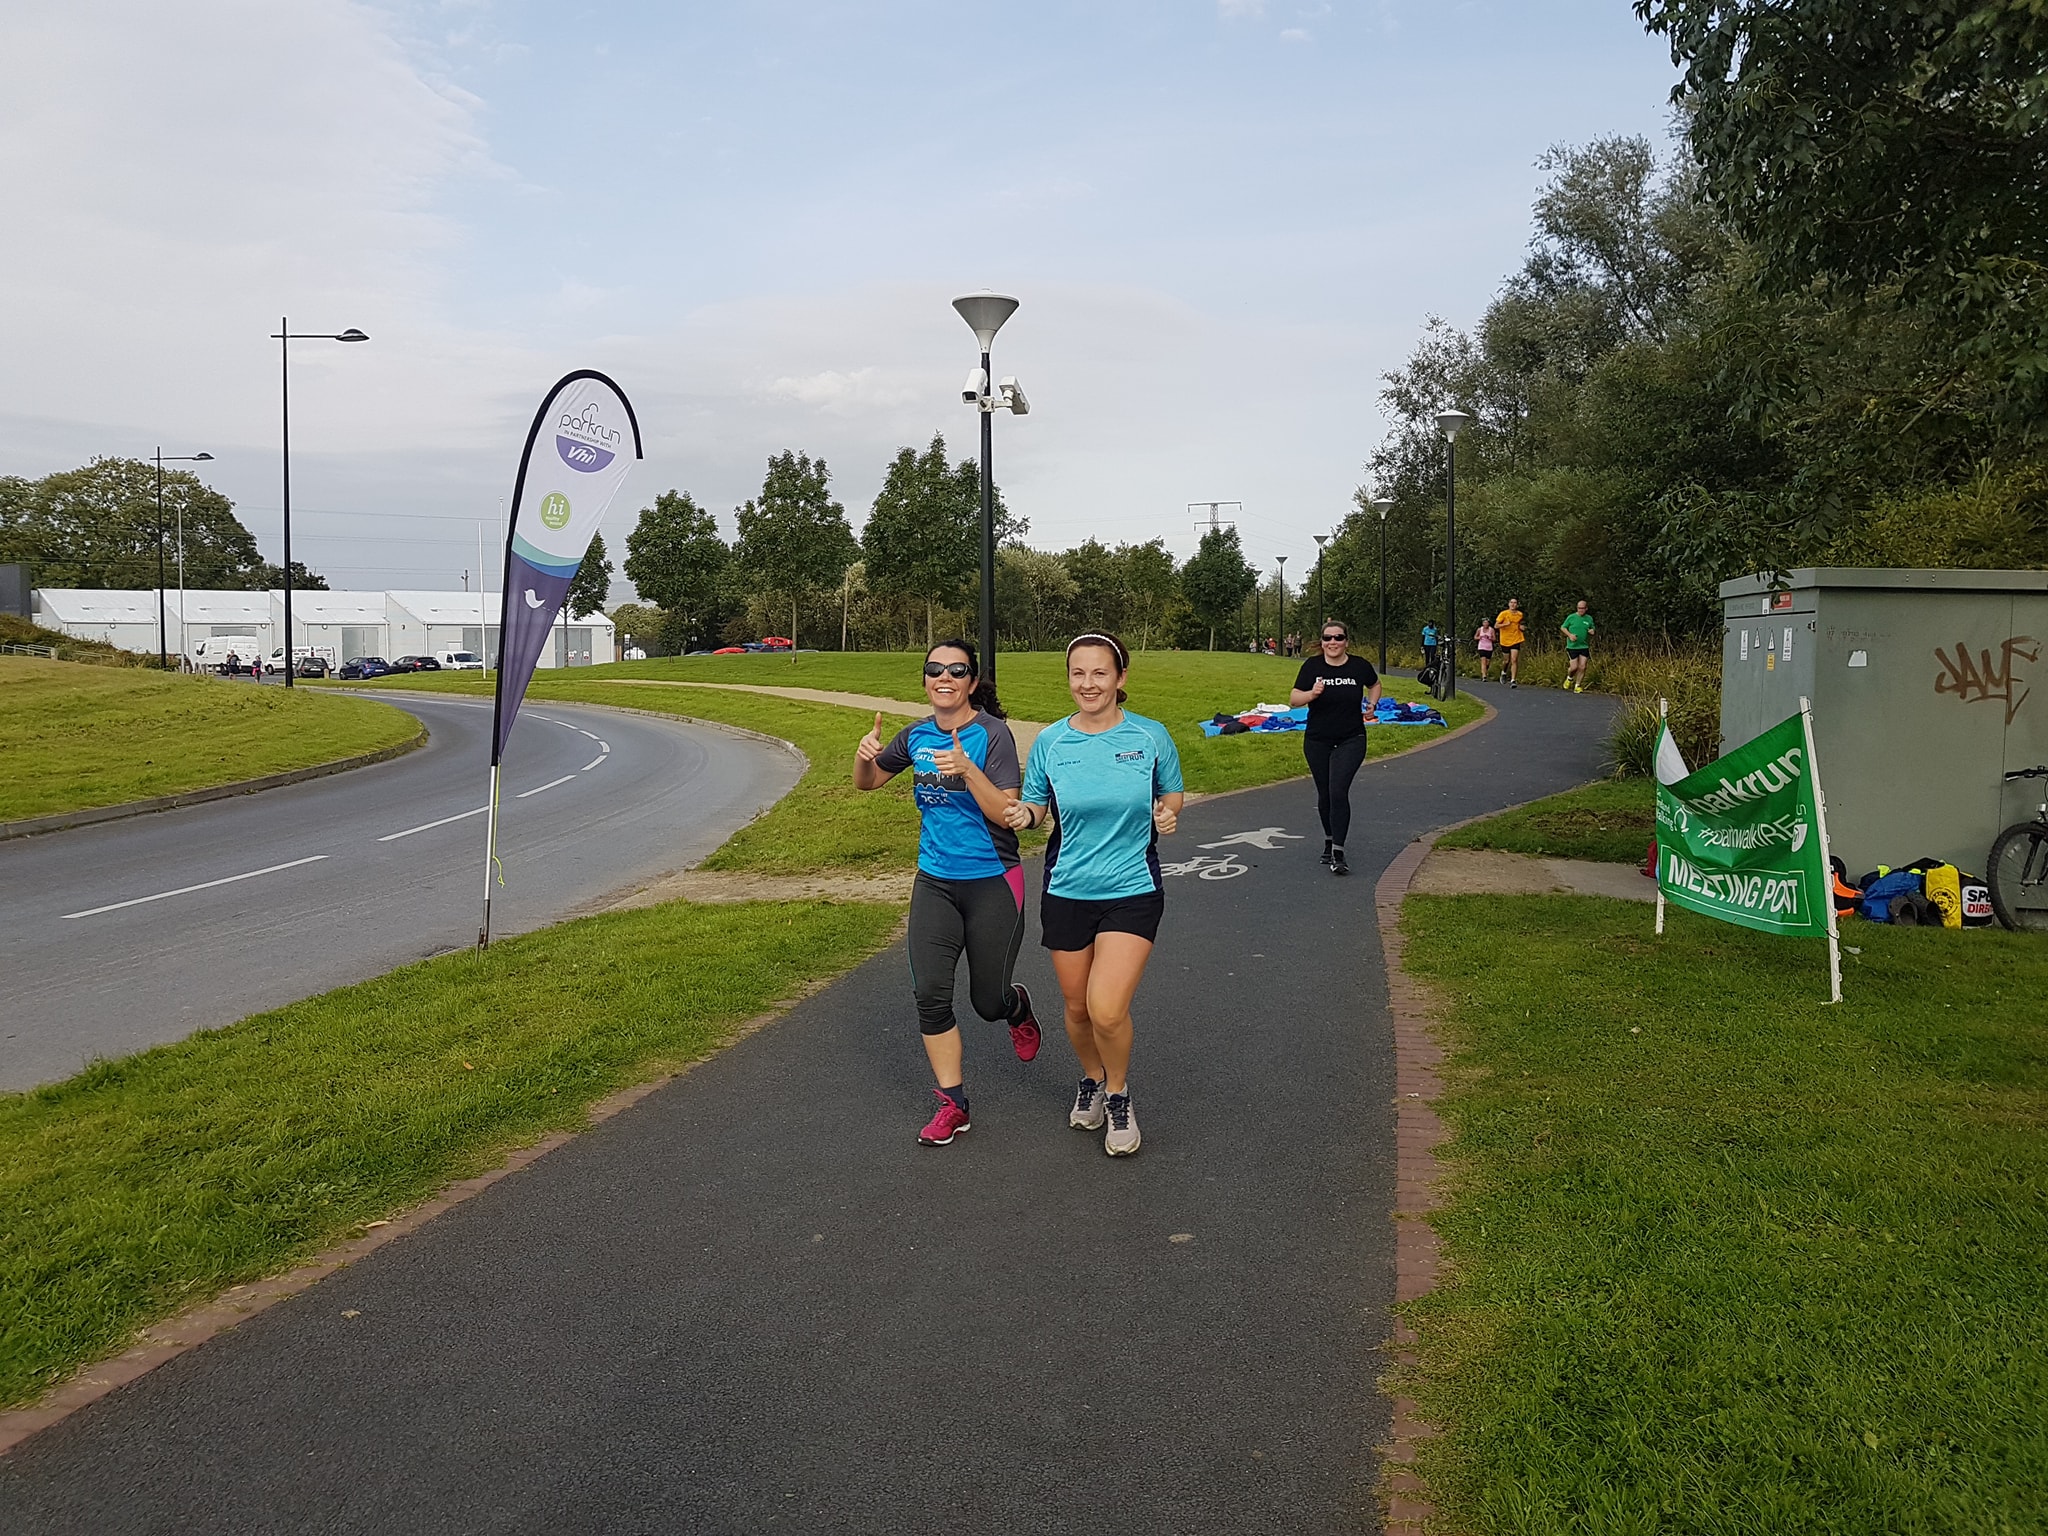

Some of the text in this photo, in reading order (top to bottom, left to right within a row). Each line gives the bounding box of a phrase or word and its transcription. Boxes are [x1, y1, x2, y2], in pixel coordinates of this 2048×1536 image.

[558, 409, 621, 445] parkrun
[570, 431, 600, 444] PARTNERSHIP
[599, 441, 612, 449] WITH
[567, 445, 597, 465] Vhi
[547, 496, 565, 515] hi
[1316, 677, 1334, 685] Frst
[1688, 748, 1801, 817] parkrun
[1668, 854, 1762, 908] MEETING
